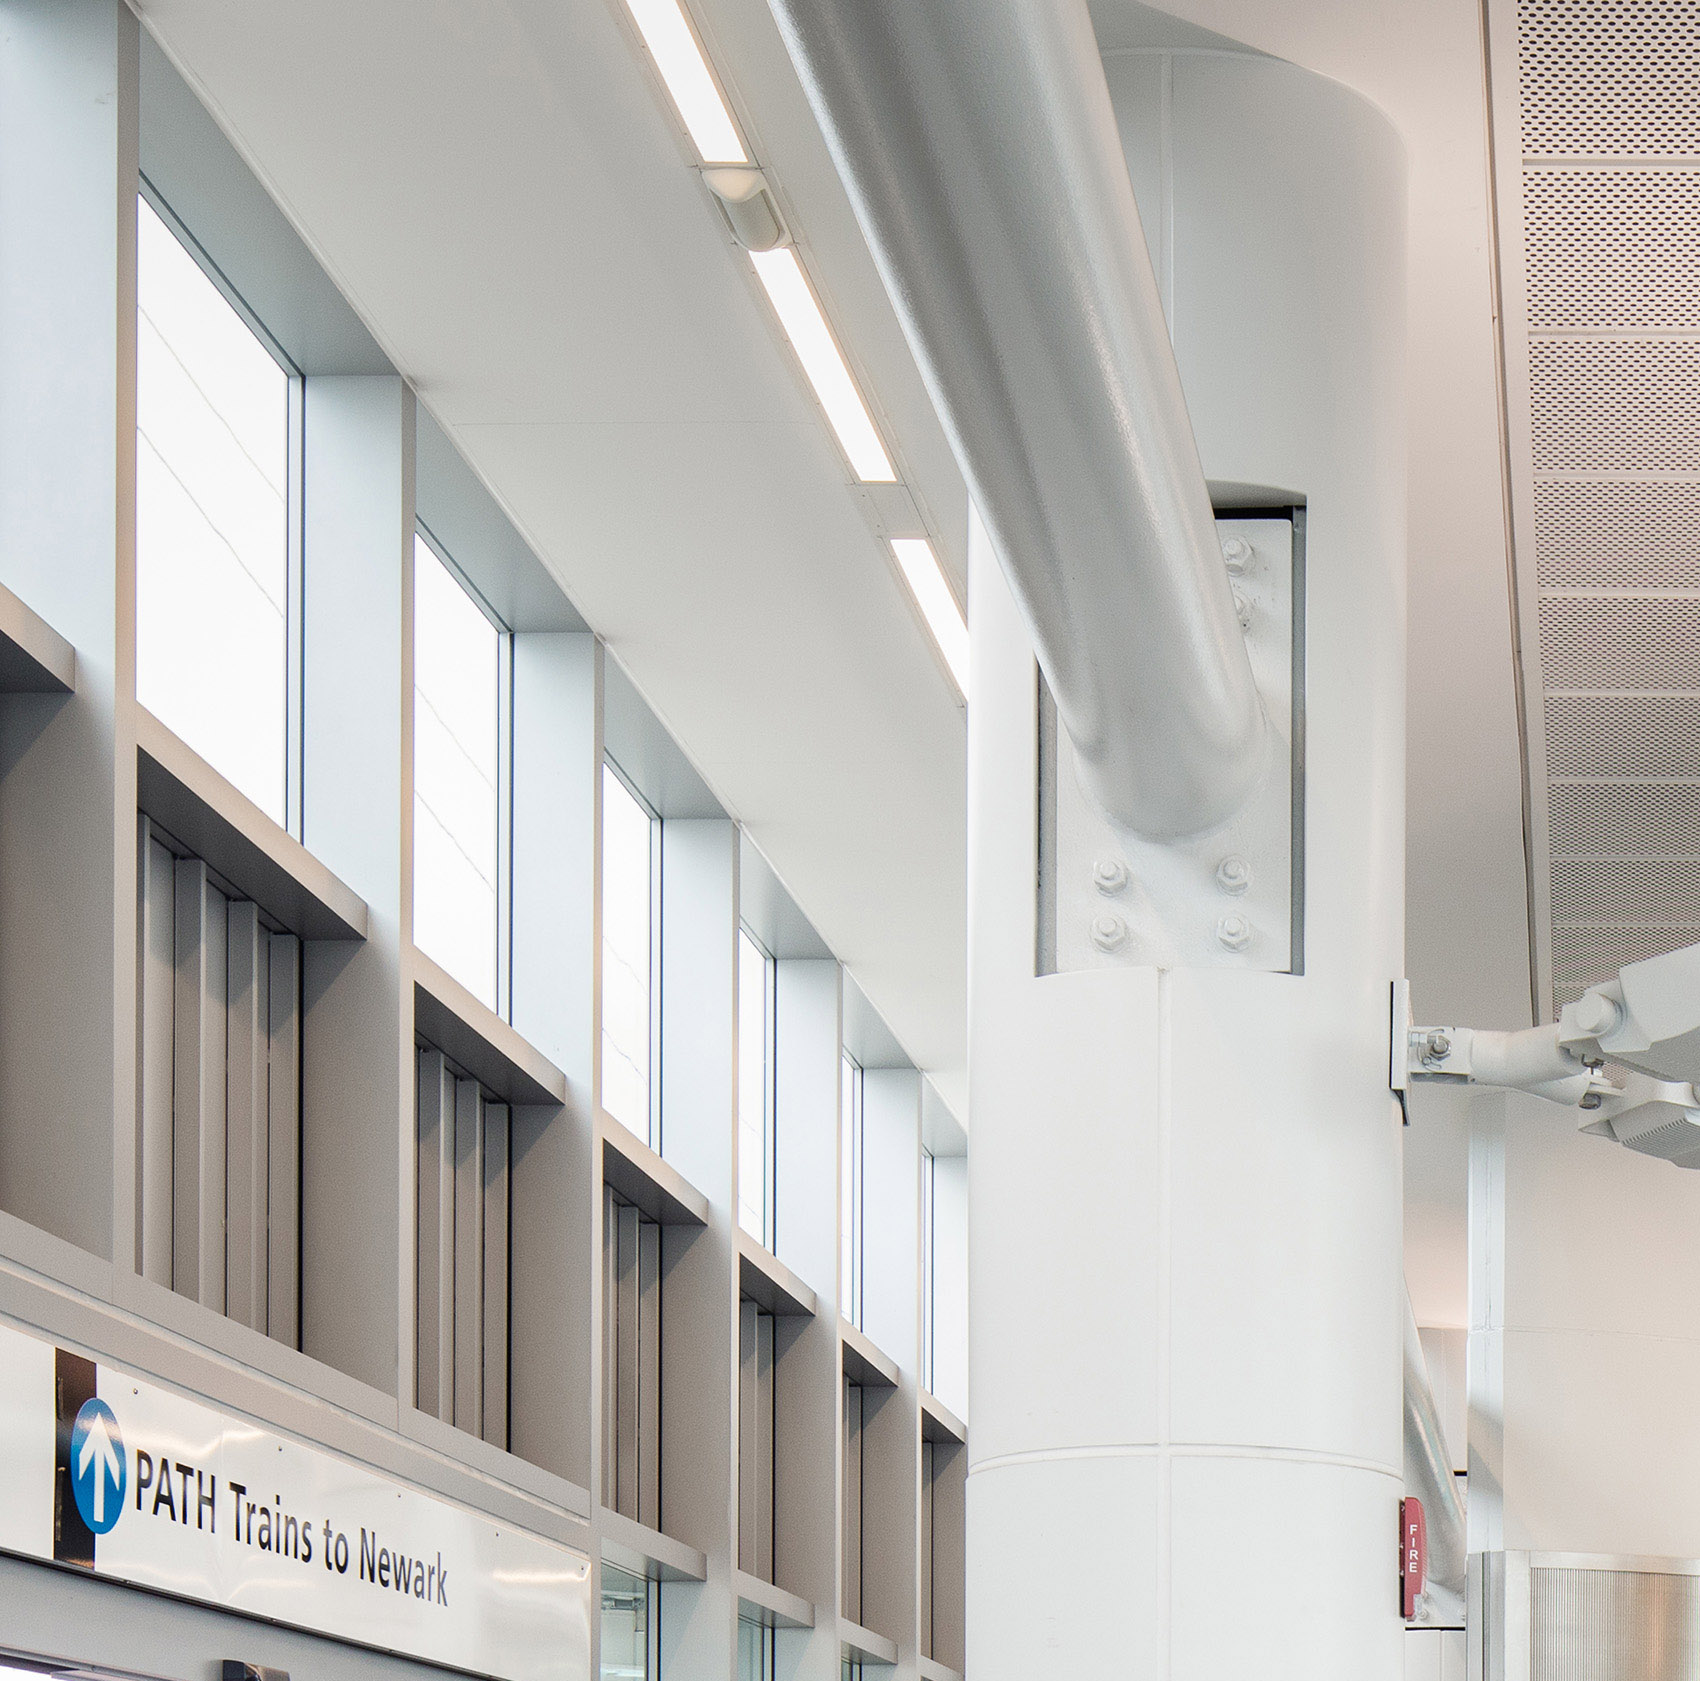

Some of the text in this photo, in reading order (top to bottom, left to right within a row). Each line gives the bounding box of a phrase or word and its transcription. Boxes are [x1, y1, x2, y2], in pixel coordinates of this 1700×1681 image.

[136, 1448, 449, 1607] PATH Trains to Newark
[1408, 1524, 1419, 1573] FIRE
